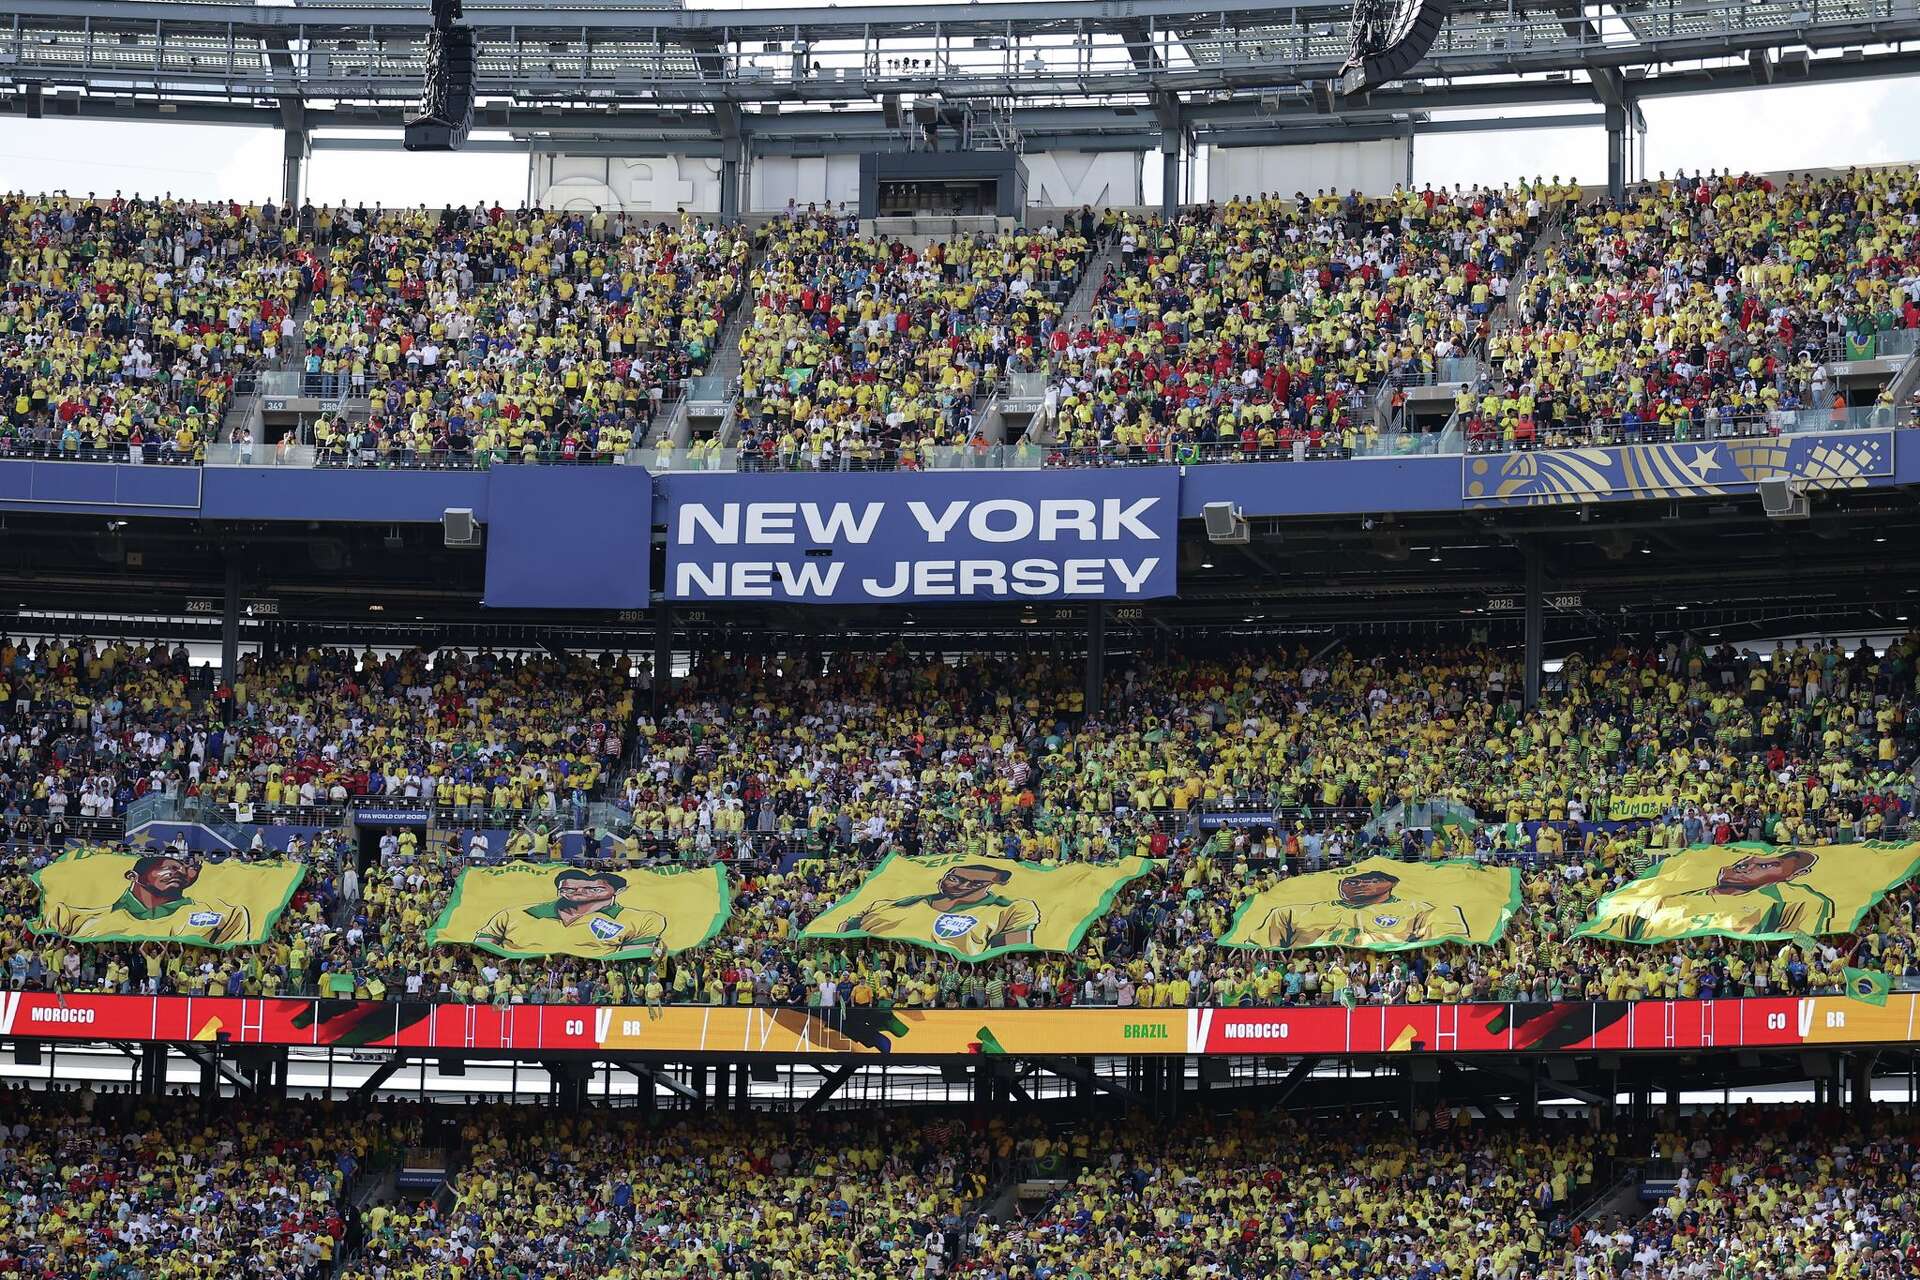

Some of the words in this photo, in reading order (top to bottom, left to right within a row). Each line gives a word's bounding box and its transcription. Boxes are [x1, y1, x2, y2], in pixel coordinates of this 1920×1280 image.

[678, 502, 885, 545] NEW
[907, 498, 1161, 543] YORK
[676, 562, 845, 597] NEW
[863, 557, 1161, 597] JERSEY
[187, 601, 212, 611] 249B
[1489, 599, 1513, 608] 202B
[1555, 597, 1581, 606] 203B
[253, 603, 278, 612] 250B
[619, 611, 645, 620] 250B
[1056, 610, 1072, 618] 201
[1117, 609, 1143, 618] 202B
[1612, 802, 1650, 815] RUMO
[31, 1007, 96, 1024] MOROCCO
[1767, 1013, 1786, 1029] CO
[1826, 1011, 1845, 1028] BR
[565, 1020, 584, 1036] CO
[623, 1021, 641, 1036] BR
[1124, 1024, 1169, 1039] BRAZIL
[1225, 1023, 1288, 1039] MOROCCO
